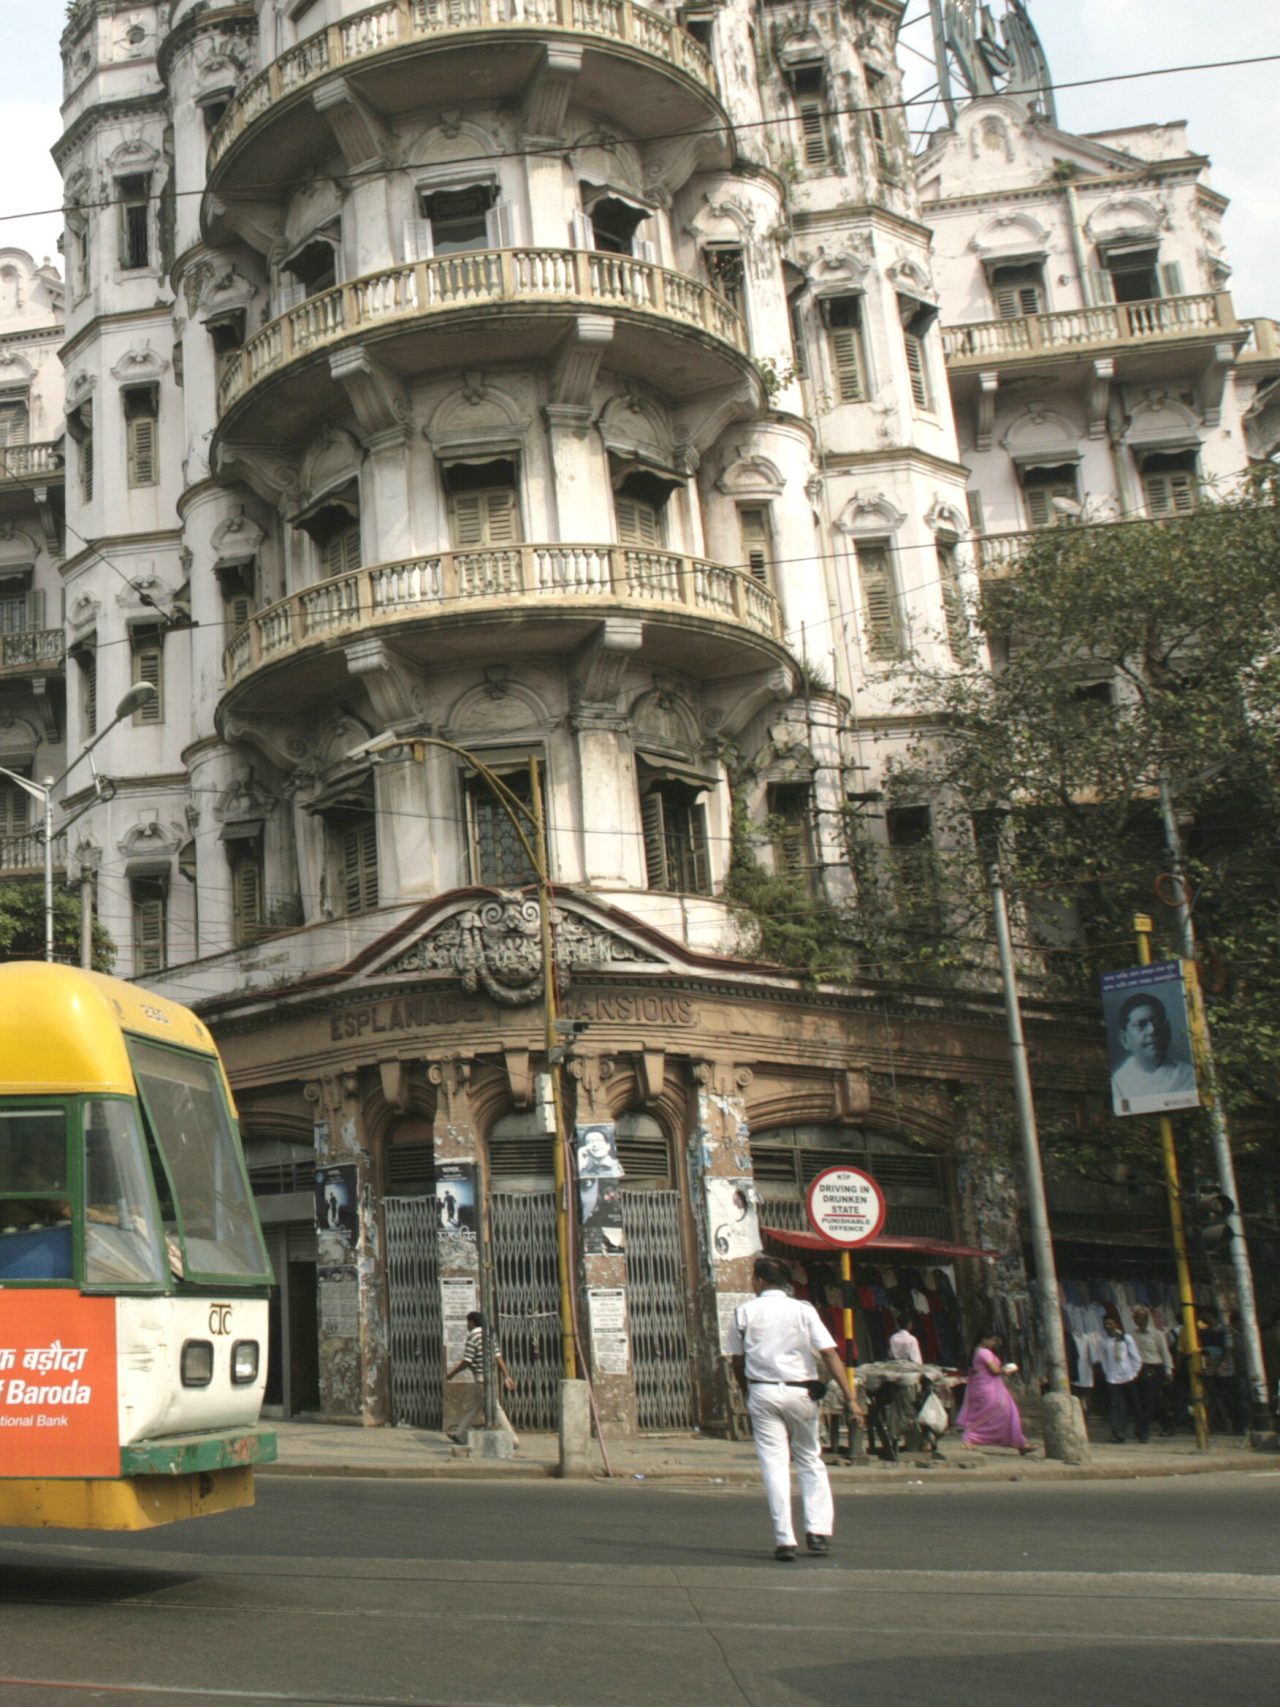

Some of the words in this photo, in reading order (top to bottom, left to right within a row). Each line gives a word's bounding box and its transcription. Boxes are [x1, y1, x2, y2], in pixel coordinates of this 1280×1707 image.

[329, 1000, 484, 1041] ESPLANADE
[819, 1184, 857, 1193] DRIVING
[822, 1195, 867, 1204] DRUNKEN
[831, 1205, 860, 1214] STATE
[821, 1217, 870, 1225] PUNISHABLE
[208, 1302, 232, 1335] CTC
[22, 1340, 89, 1376] बड़ौदा
[6, 1379, 92, 1405] Baroda
[36, 1414, 68, 1427] Bank
